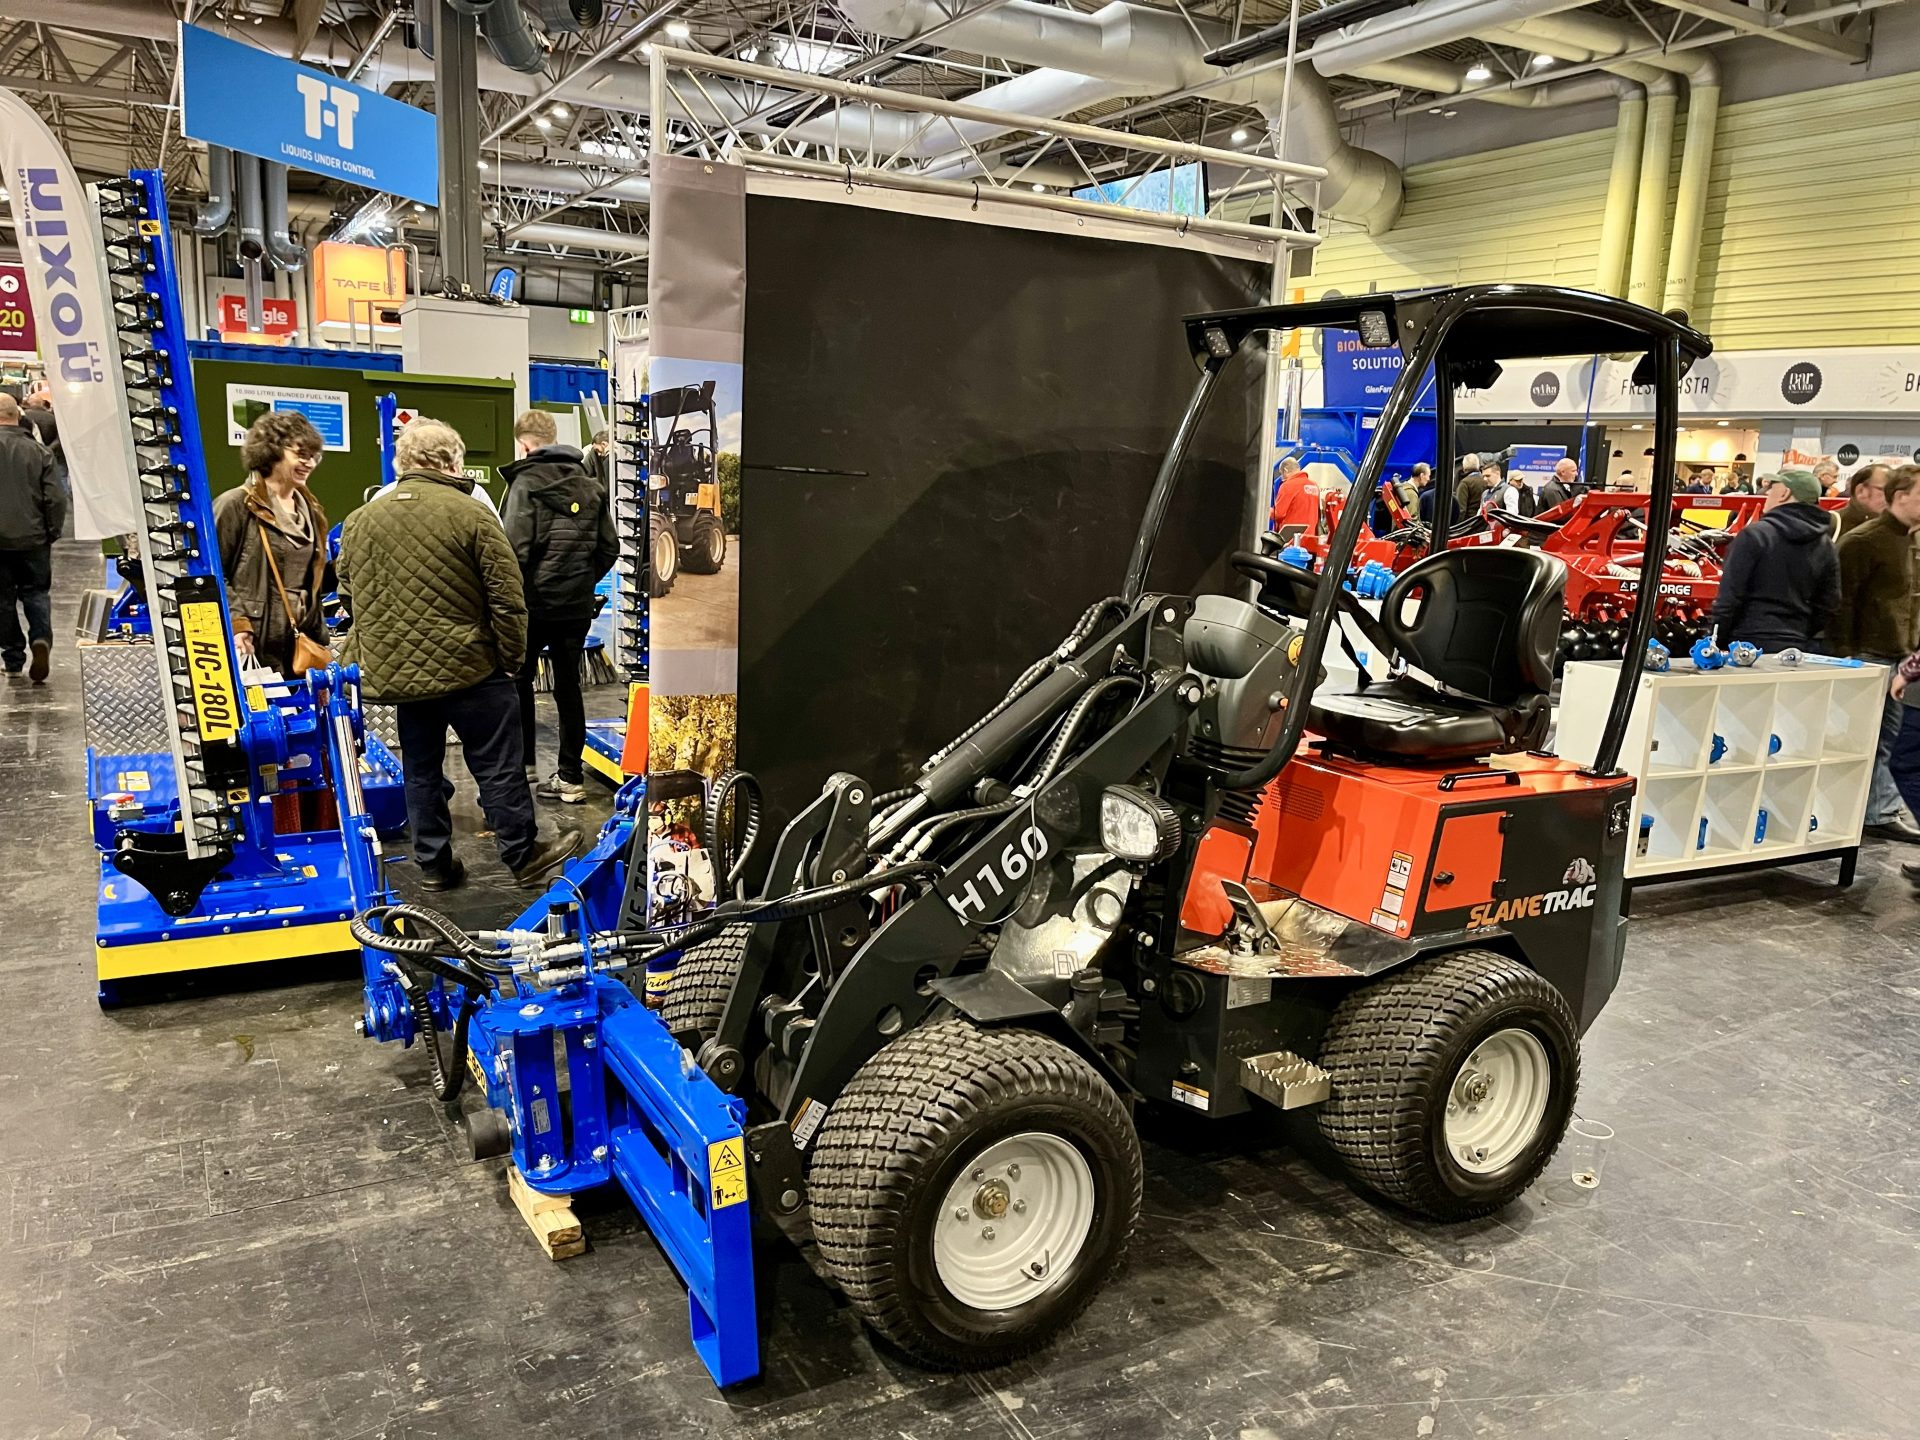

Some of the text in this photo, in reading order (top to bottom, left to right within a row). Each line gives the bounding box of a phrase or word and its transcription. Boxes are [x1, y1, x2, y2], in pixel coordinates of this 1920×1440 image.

[281, 142, 376, 180] LIQUIDS UNDER CONTROL
[333, 278, 381, 291] TAFE
[0, 309, 25, 329] 20
[231, 303, 288, 325] Tegle
[277, 391, 305, 399] BUNDED
[1630, 583, 1691, 595] PORGE
[192, 640, 232, 733] HC-180L
[947, 825, 1049, 926] H160
[1466, 884, 1597, 929] SLANETRAC
